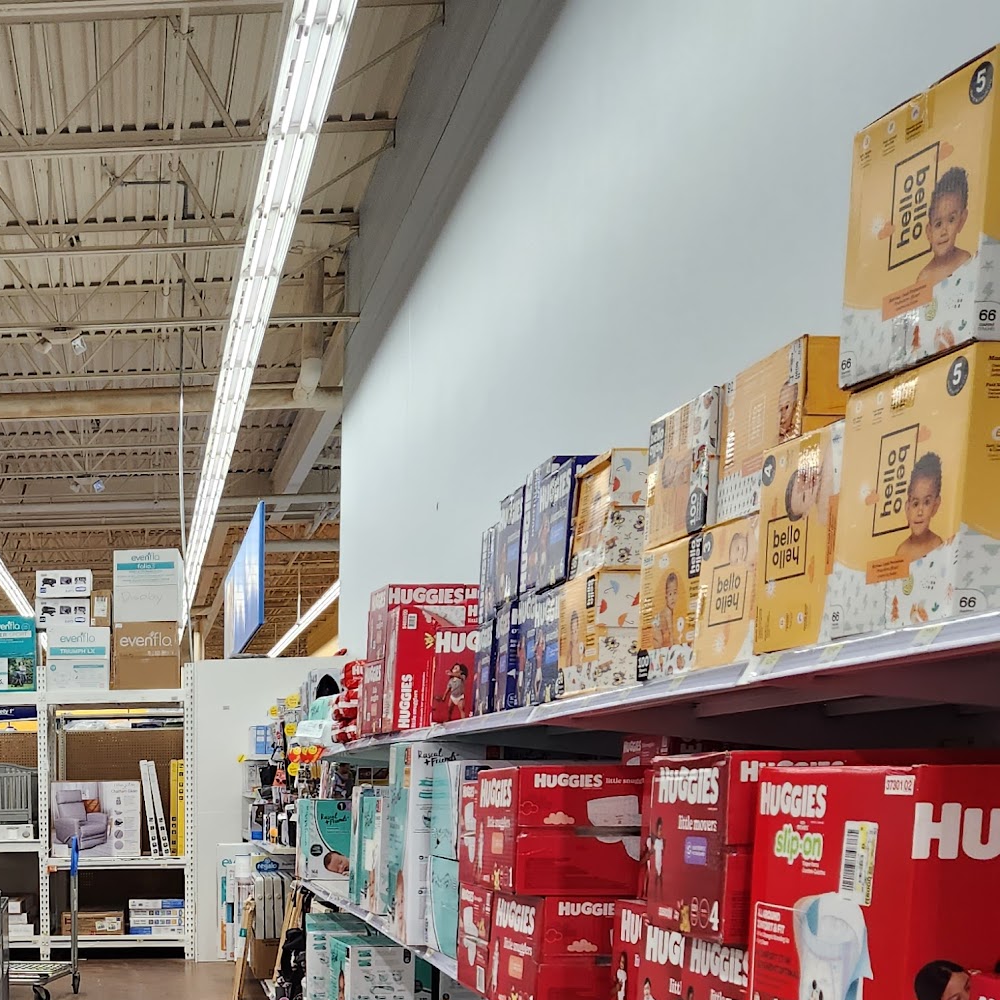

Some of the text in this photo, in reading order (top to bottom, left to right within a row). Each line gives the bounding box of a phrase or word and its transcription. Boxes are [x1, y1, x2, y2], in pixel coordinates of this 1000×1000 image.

[974, 69, 987, 93] 5
[912, 165, 930, 239] bello
[897, 175, 914, 249] hello
[978, 309, 996, 321] 66
[841, 358, 852, 370] 66
[952, 361, 962, 386] 5
[880, 450, 896, 518] hello
[893, 444, 910, 514] bello
[773, 530, 801, 546] bello
[131, 552, 160, 561] evenflo
[772, 551, 799, 569] hello
[717, 575, 741, 592] bello
[389, 588, 464, 604] HUGGIES
[715, 594, 738, 612] hello
[959, 596, 977, 608] 66
[60, 632, 95, 643] evenflo
[120, 631, 172, 647] evenflo
[398, 674, 413, 728] HUGGIES
[418, 749, 443, 759] Rascal
[534, 773, 603, 788] HUGGIES
[658, 766, 719, 805] HUGGIES
[480, 778, 512, 808] HUGGIES
[760, 782, 827, 818] HUGGIES
[678, 815, 717, 832] little movers
[495, 901, 536, 935] HUGGIES
[709, 905, 719, 932] 4
